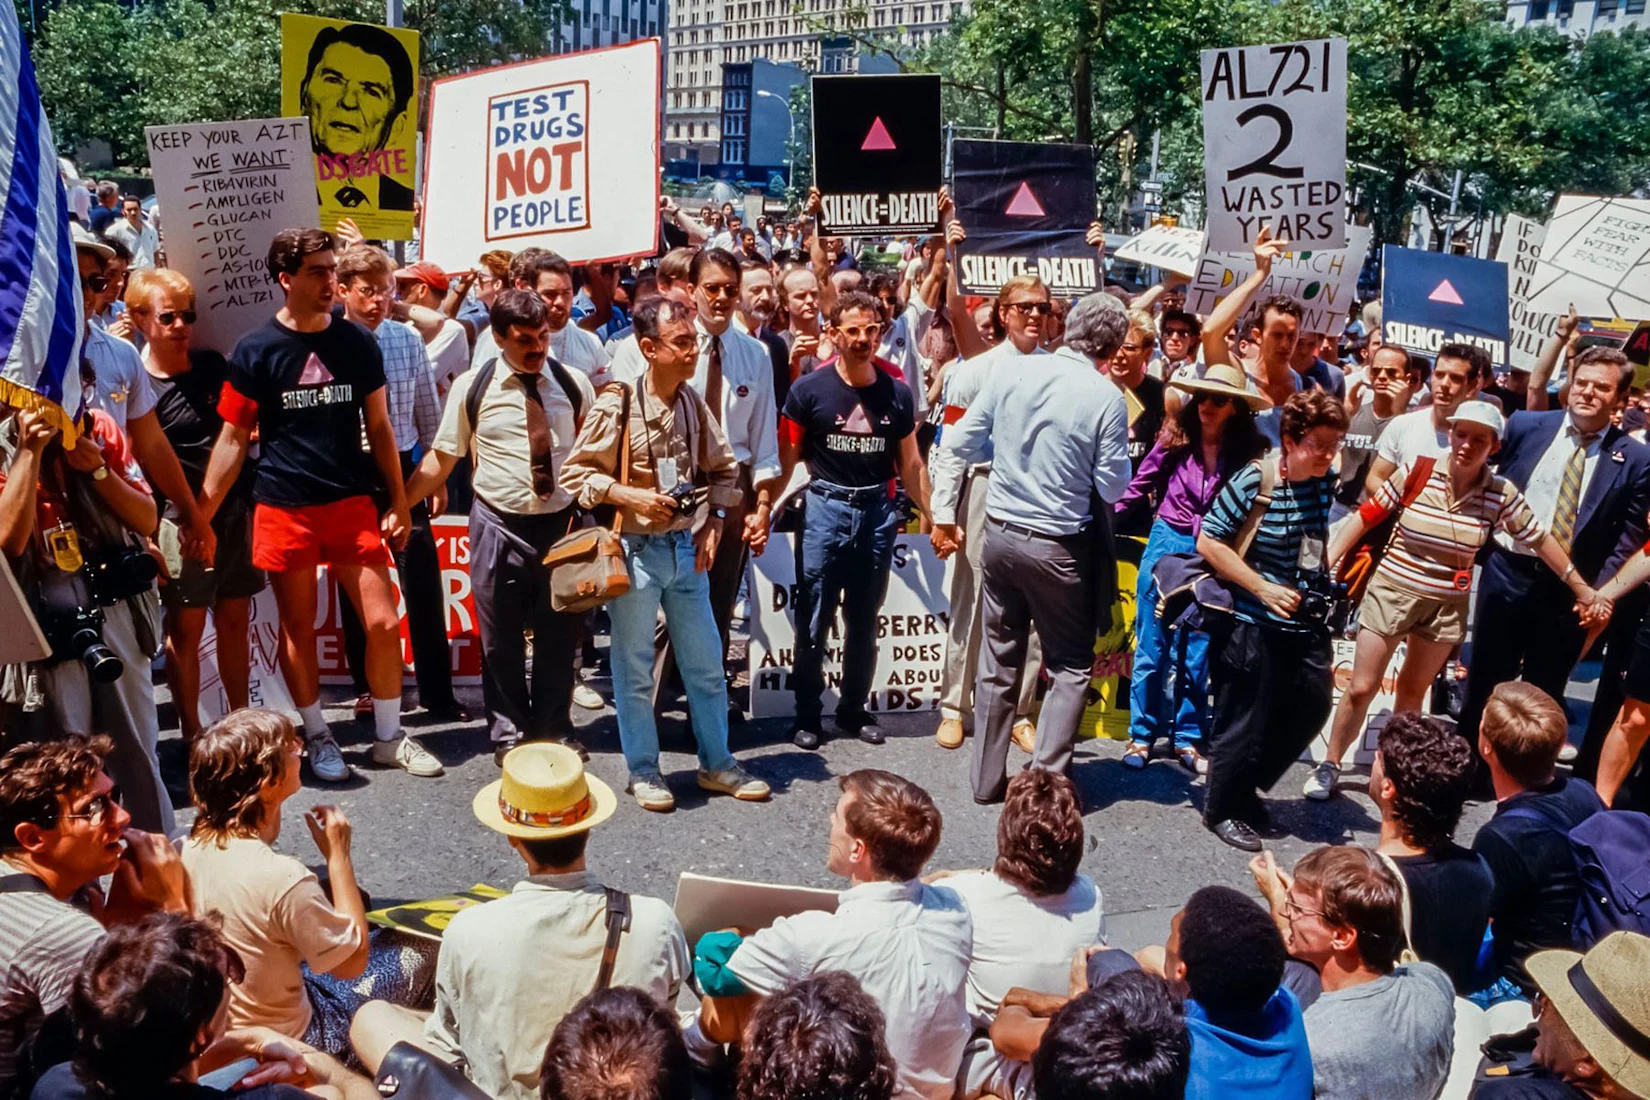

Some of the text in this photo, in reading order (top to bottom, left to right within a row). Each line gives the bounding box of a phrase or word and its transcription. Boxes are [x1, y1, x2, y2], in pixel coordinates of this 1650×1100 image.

[491, 89, 574, 122] TEST
[150, 131, 193, 152] KEEP
[200, 130, 243, 149] YOUR
[495, 113, 584, 148] DRUGS
[1227, 104, 1304, 182] 2
[192, 152, 222, 169] WE
[496, 141, 583, 201] NOT
[202, 174, 277, 193] RIBAVIRIN
[206, 190, 284, 209] AMPLIGEN
[1221, 181, 1342, 213] WASTED
[207, 209, 271, 226] GLUCAN
[493, 196, 583, 231] PEOPLE
[821, 192, 939, 226] SILENCE=DEATH
[213, 229, 246, 243] DTC
[1236, 211, 1334, 243] YEARS
[1518, 220, 1535, 238] IF
[1592, 226, 1640, 244] FEAR
[218, 244, 251, 260] DDC
[1584, 237, 1629, 256] WITH
[961, 254, 1097, 288] SILENCE=DEATH
[1197, 259, 1340, 306] EDUATION
[282, 384, 352, 410] SILENCE=DEATH
[826, 433, 886, 453] SILENCE=DEATH
[893, 643, 941, 662] DOES
[887, 668, 943, 686] ABOU
